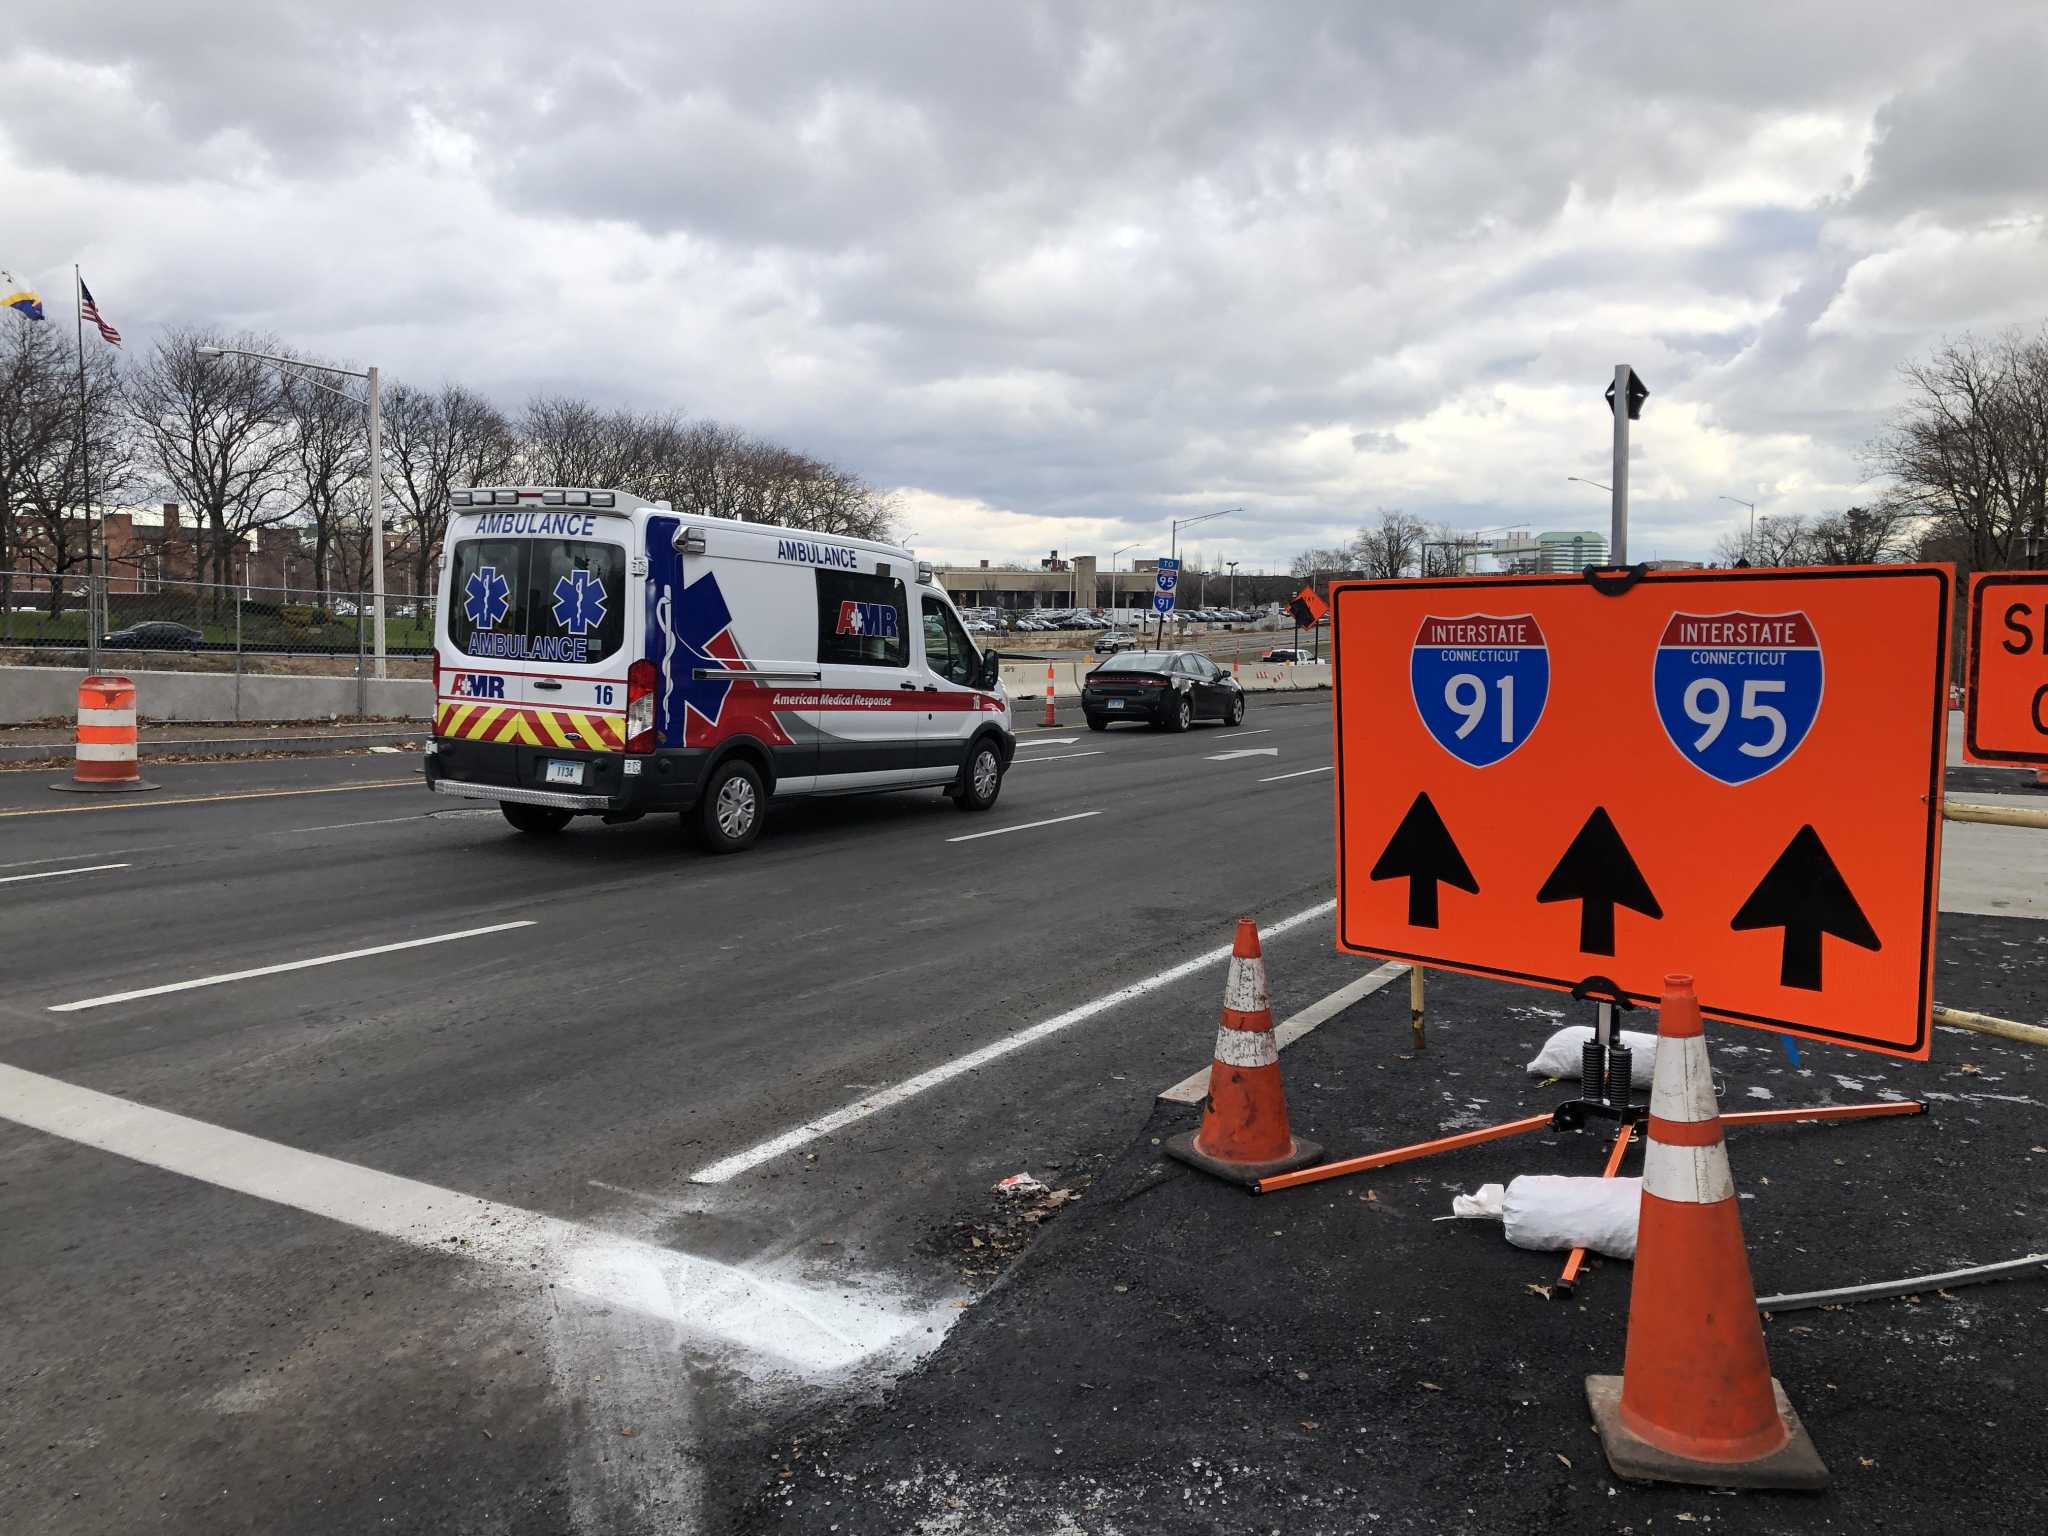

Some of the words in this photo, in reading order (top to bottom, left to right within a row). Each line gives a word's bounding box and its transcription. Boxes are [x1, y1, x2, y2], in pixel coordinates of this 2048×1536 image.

[475, 513, 597, 536] AMBULANCE
[777, 540, 857, 568] AMBULANCE
[1164, 560, 1174, 568] TO
[1160, 576, 1174, 587] 95
[1158, 598, 1169, 609] 91
[835, 600, 898, 638] AMR
[1431, 624, 1527, 643] INTERSTATE
[1680, 622, 1796, 644] INTERSTATE
[467, 632, 587, 662] AMBULANCE
[1441, 650, 1520, 663] CONNECTICUT
[1691, 651, 1787, 666] CONNECTICUT
[451, 673, 505, 698] AMR
[594, 685, 613, 706] 16
[773, 693, 819, 705] American
[820, 693, 855, 705] Medical
[855, 694, 892, 708] Response
[1444, 673, 1514, 743] 91
[1683, 677, 1787, 758] 95
